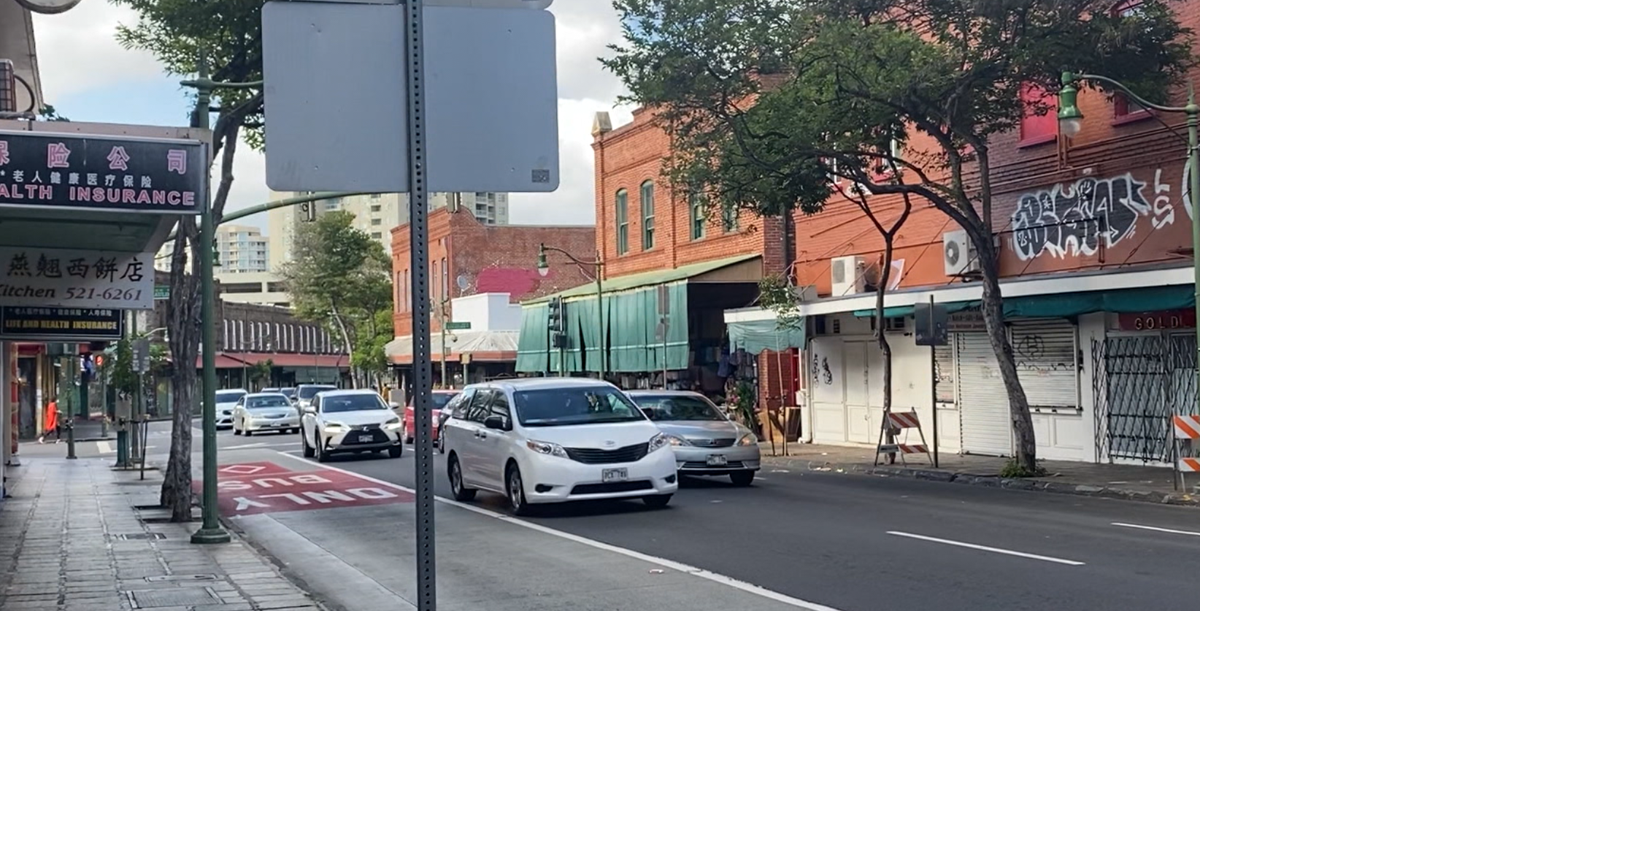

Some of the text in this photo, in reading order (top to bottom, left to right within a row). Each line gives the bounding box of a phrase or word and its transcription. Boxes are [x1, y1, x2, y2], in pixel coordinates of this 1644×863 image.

[13, 170, 152, 188] 老人健康医疗保险
[69, 186, 195, 206] INSURANCE
[7, 252, 144, 283] 燕翹西餅店
[65, 287, 142, 301] 521-6261
[5, 319, 117, 330] LIFE AND HEALTH INSURANCE
[217, 474, 332, 490] BUS
[232, 487, 398, 511] ONLY
